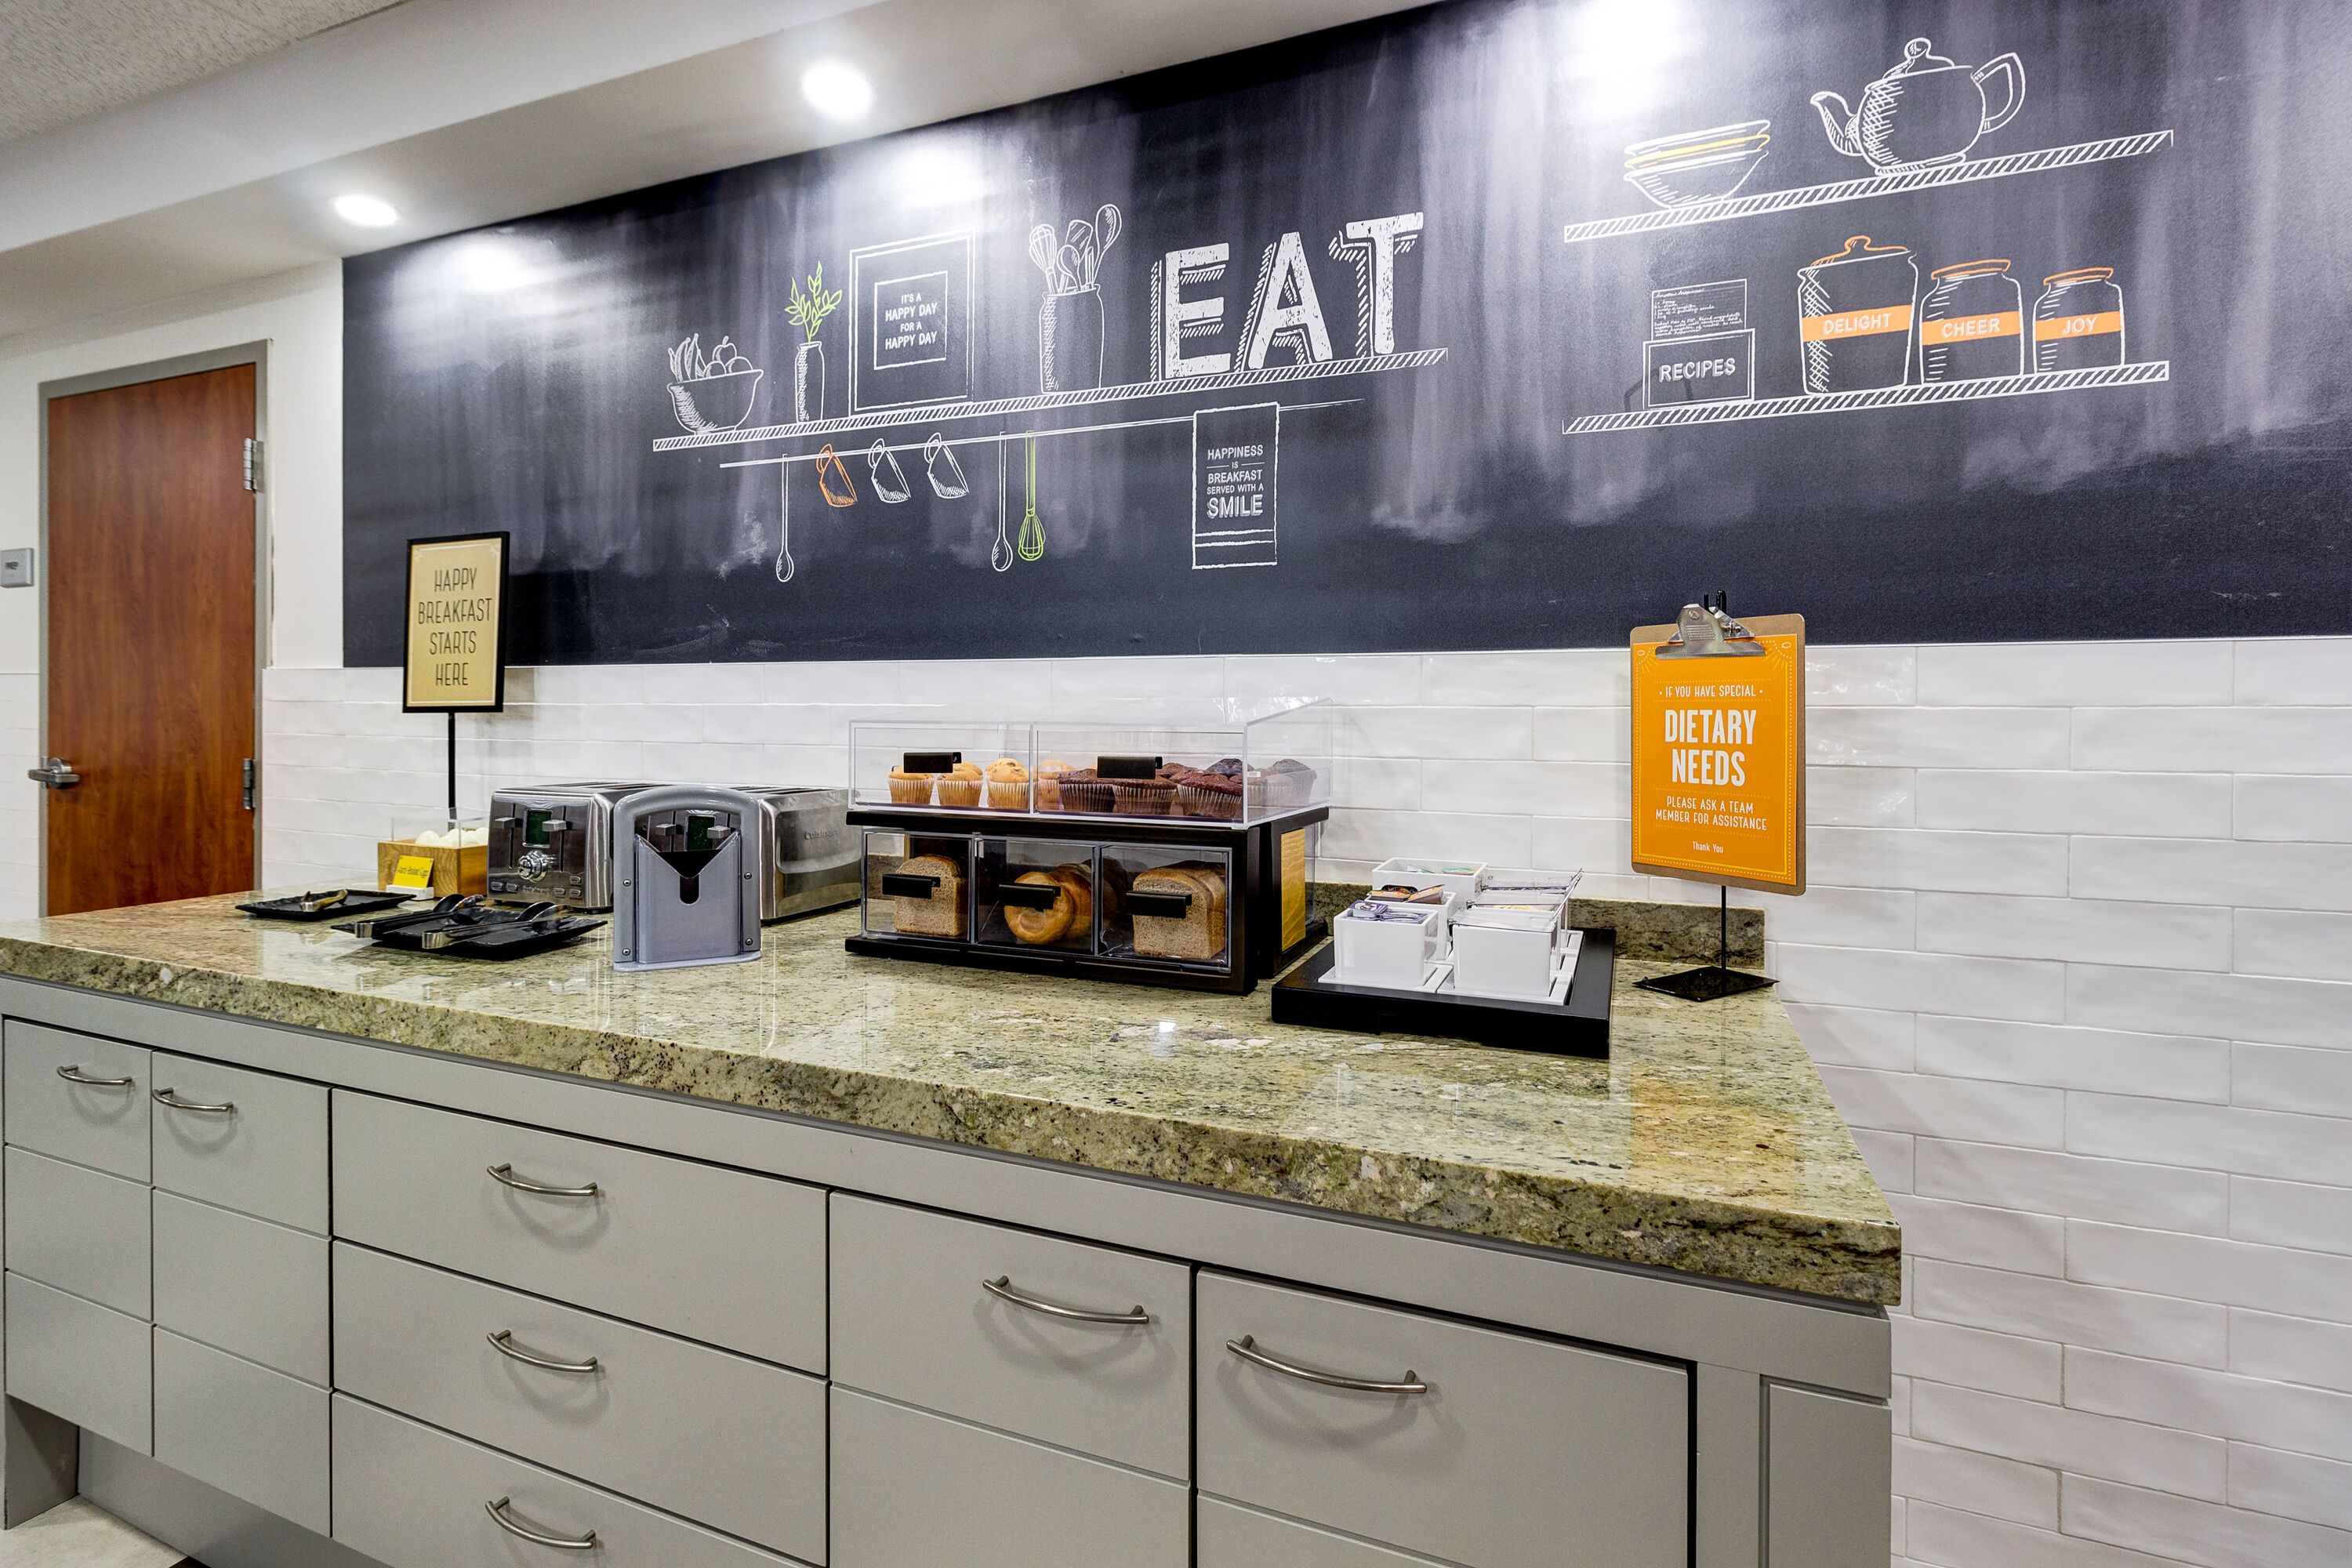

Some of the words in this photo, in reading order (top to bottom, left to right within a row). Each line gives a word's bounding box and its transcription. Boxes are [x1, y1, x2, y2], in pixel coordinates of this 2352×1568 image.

[901, 293, 914, 304] IT'S
[916, 292, 922, 302] A
[1151, 212, 1423, 379] EAT
[884, 306, 916, 321] HAPPY
[919, 303, 938, 317] DAY
[900, 322, 915, 333] FOR
[916, 321, 922, 330] A
[1823, 313, 1892, 335] DELIGHT
[1940, 318, 2000, 338] CHEER
[2061, 316, 2098, 335] JOY
[884, 334, 916, 350] HAPPY
[919, 331, 938, 346] DAY
[1659, 358, 1736, 383] RECIPES
[1207, 445, 1263, 461] HAPPINESS
[1207, 469, 1263, 485] BREAKFAST
[1207, 485, 1235, 495] SERVED
[1237, 483, 1256, 493] WITH
[1258, 483, 1264, 492] A
[1207, 494, 1263, 519] SMILE
[434, 567, 477, 593] HAPPY
[418, 597, 492, 625] BREAKFAST
[429, 630, 477, 655] STARTS
[435, 662, 470, 687] HERE
[1665, 686, 1673, 698] IF
[1675, 685, 1691, 697] YOU
[1694, 684, 1715, 697] HAVE
[1719, 684, 1756, 697] SPECIAL
[1664, 709, 1757, 745] DIETARY
[1671, 748, 1746, 787] NEEDS
[1667, 796, 1697, 810] PLEASE
[1700, 798, 1717, 811] ASK
[1719, 799, 1726, 811] A
[1729, 800, 1754, 814] TEAM
[1655, 808, 1690, 822] MEMBER
[1693, 811, 1710, 824] FOR
[1712, 813, 1767, 831] ASSISTANCE
[1692, 840, 1710, 852] Thank
[1712, 843, 1724, 854] You
